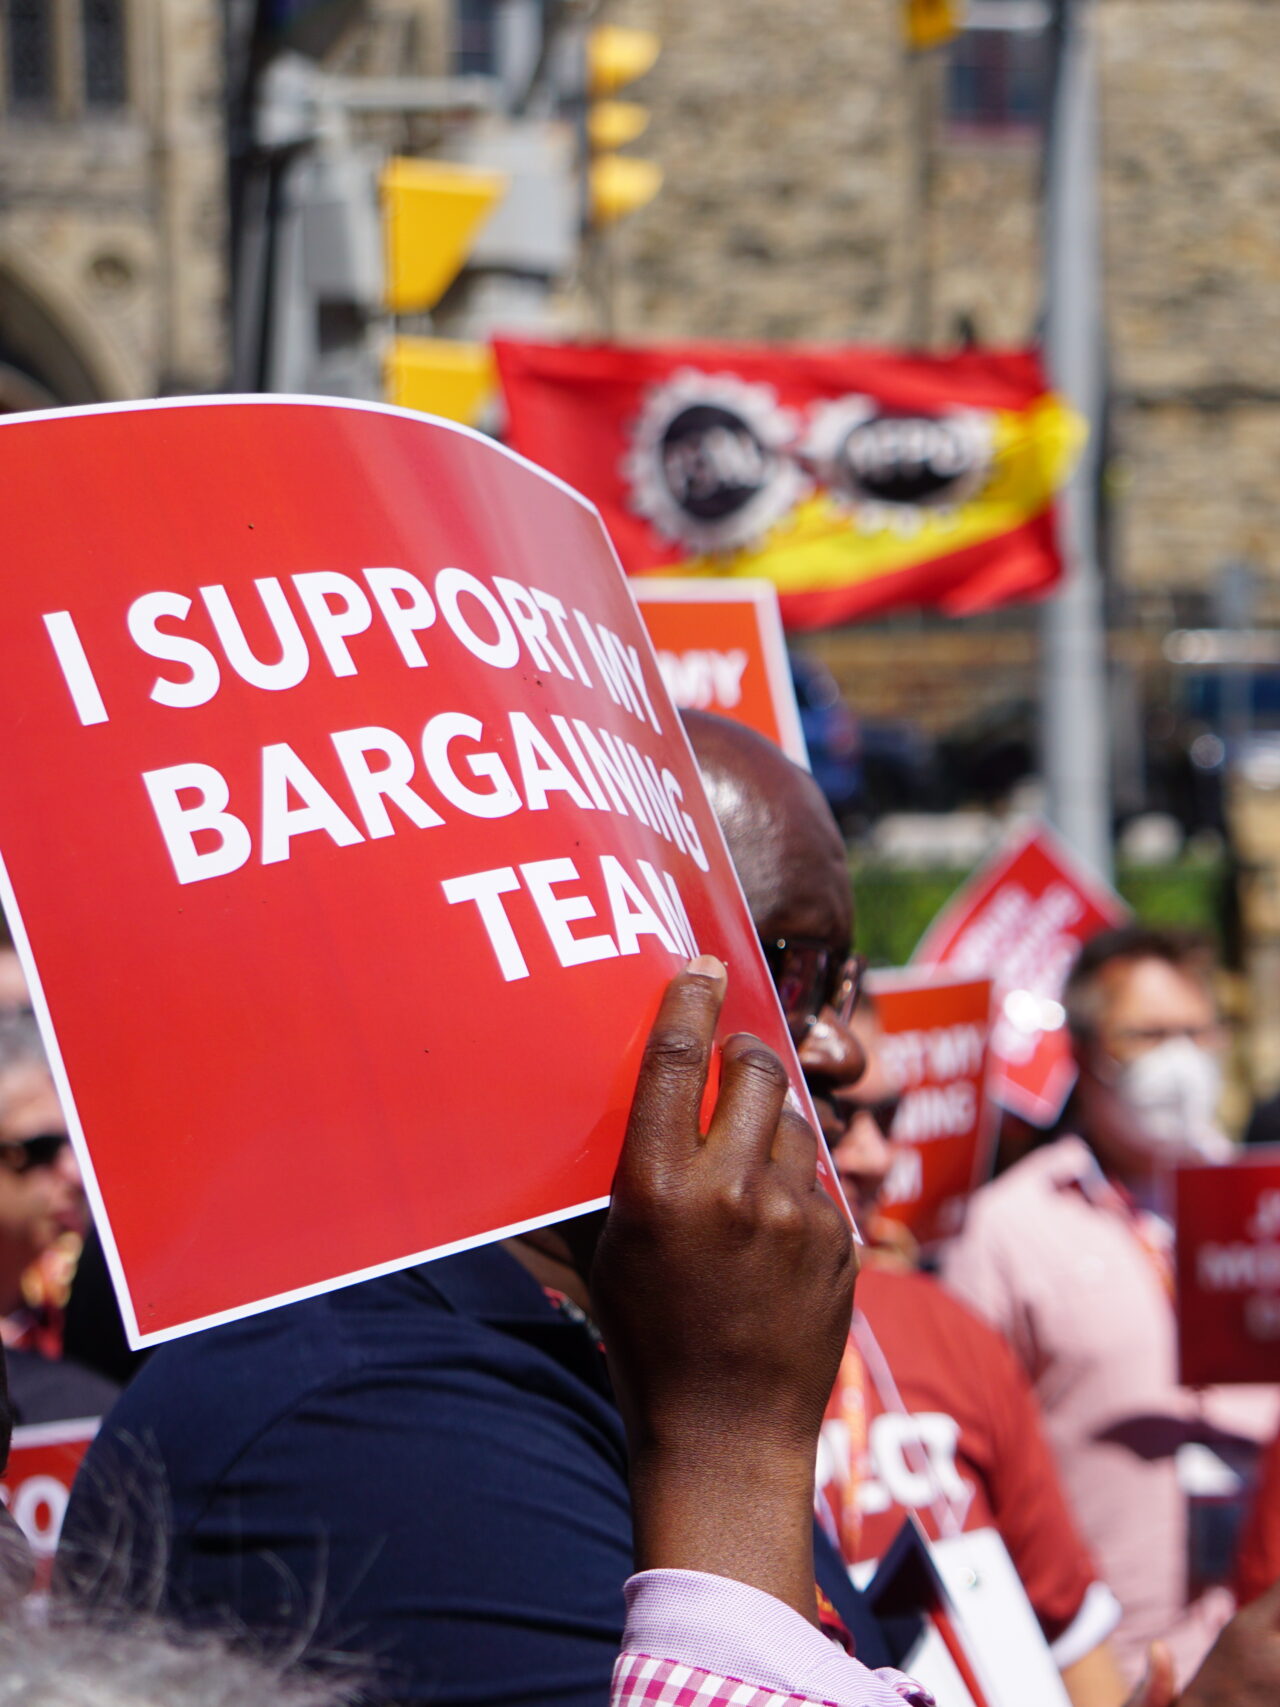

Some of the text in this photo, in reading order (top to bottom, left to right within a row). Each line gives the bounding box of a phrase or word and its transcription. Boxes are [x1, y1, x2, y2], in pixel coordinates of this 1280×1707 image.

[43, 567, 663, 736] I SUPPORT MY
[142, 712, 711, 886] BARGAINING
[441, 856, 701, 982] TEAM
